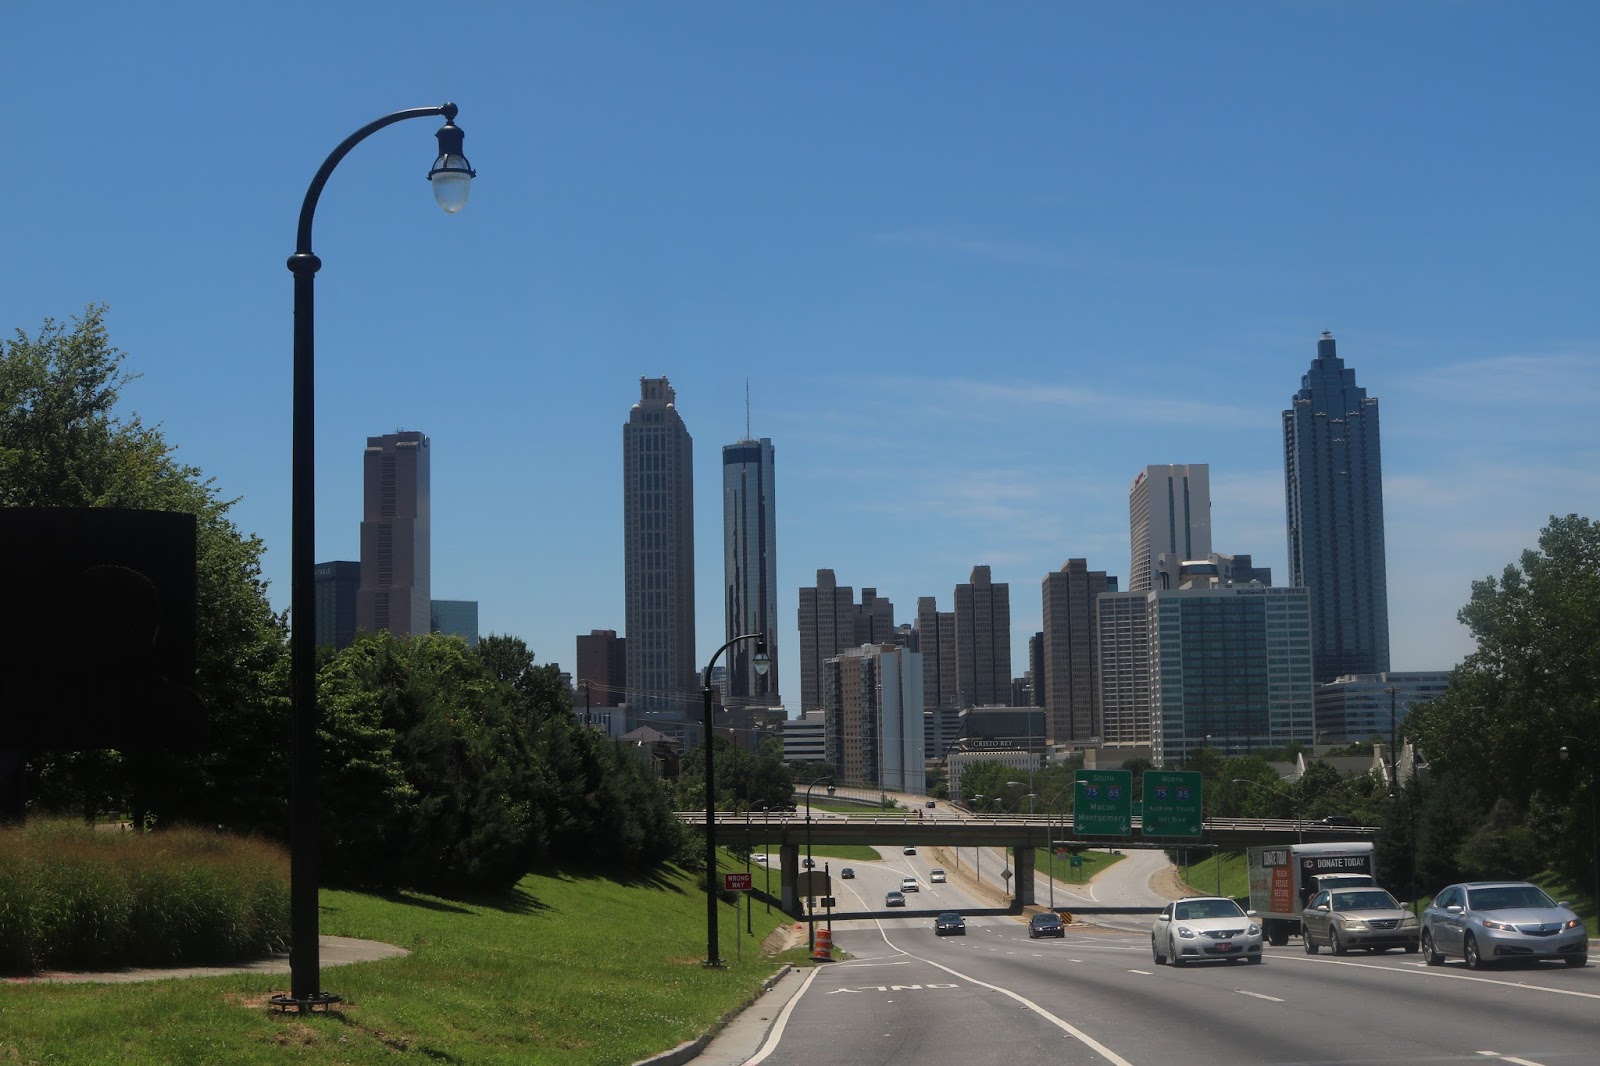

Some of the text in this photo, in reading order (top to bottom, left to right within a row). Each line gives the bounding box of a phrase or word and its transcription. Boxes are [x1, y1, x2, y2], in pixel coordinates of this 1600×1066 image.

[1093, 774, 1114, 782] SOUTH
[1087, 788, 1120, 797] 75 85
[1156, 789, 1189, 798] 75 85
[1090, 803, 1115, 811] Macon
[1176, 805, 1196, 813] Young
[1078, 814, 1126, 823] Montgomery
[1263, 850, 1287, 865] DONATE TODAY
[1317, 857, 1364, 868] DONATE TODAY
[824, 983, 959, 995] ONLY
